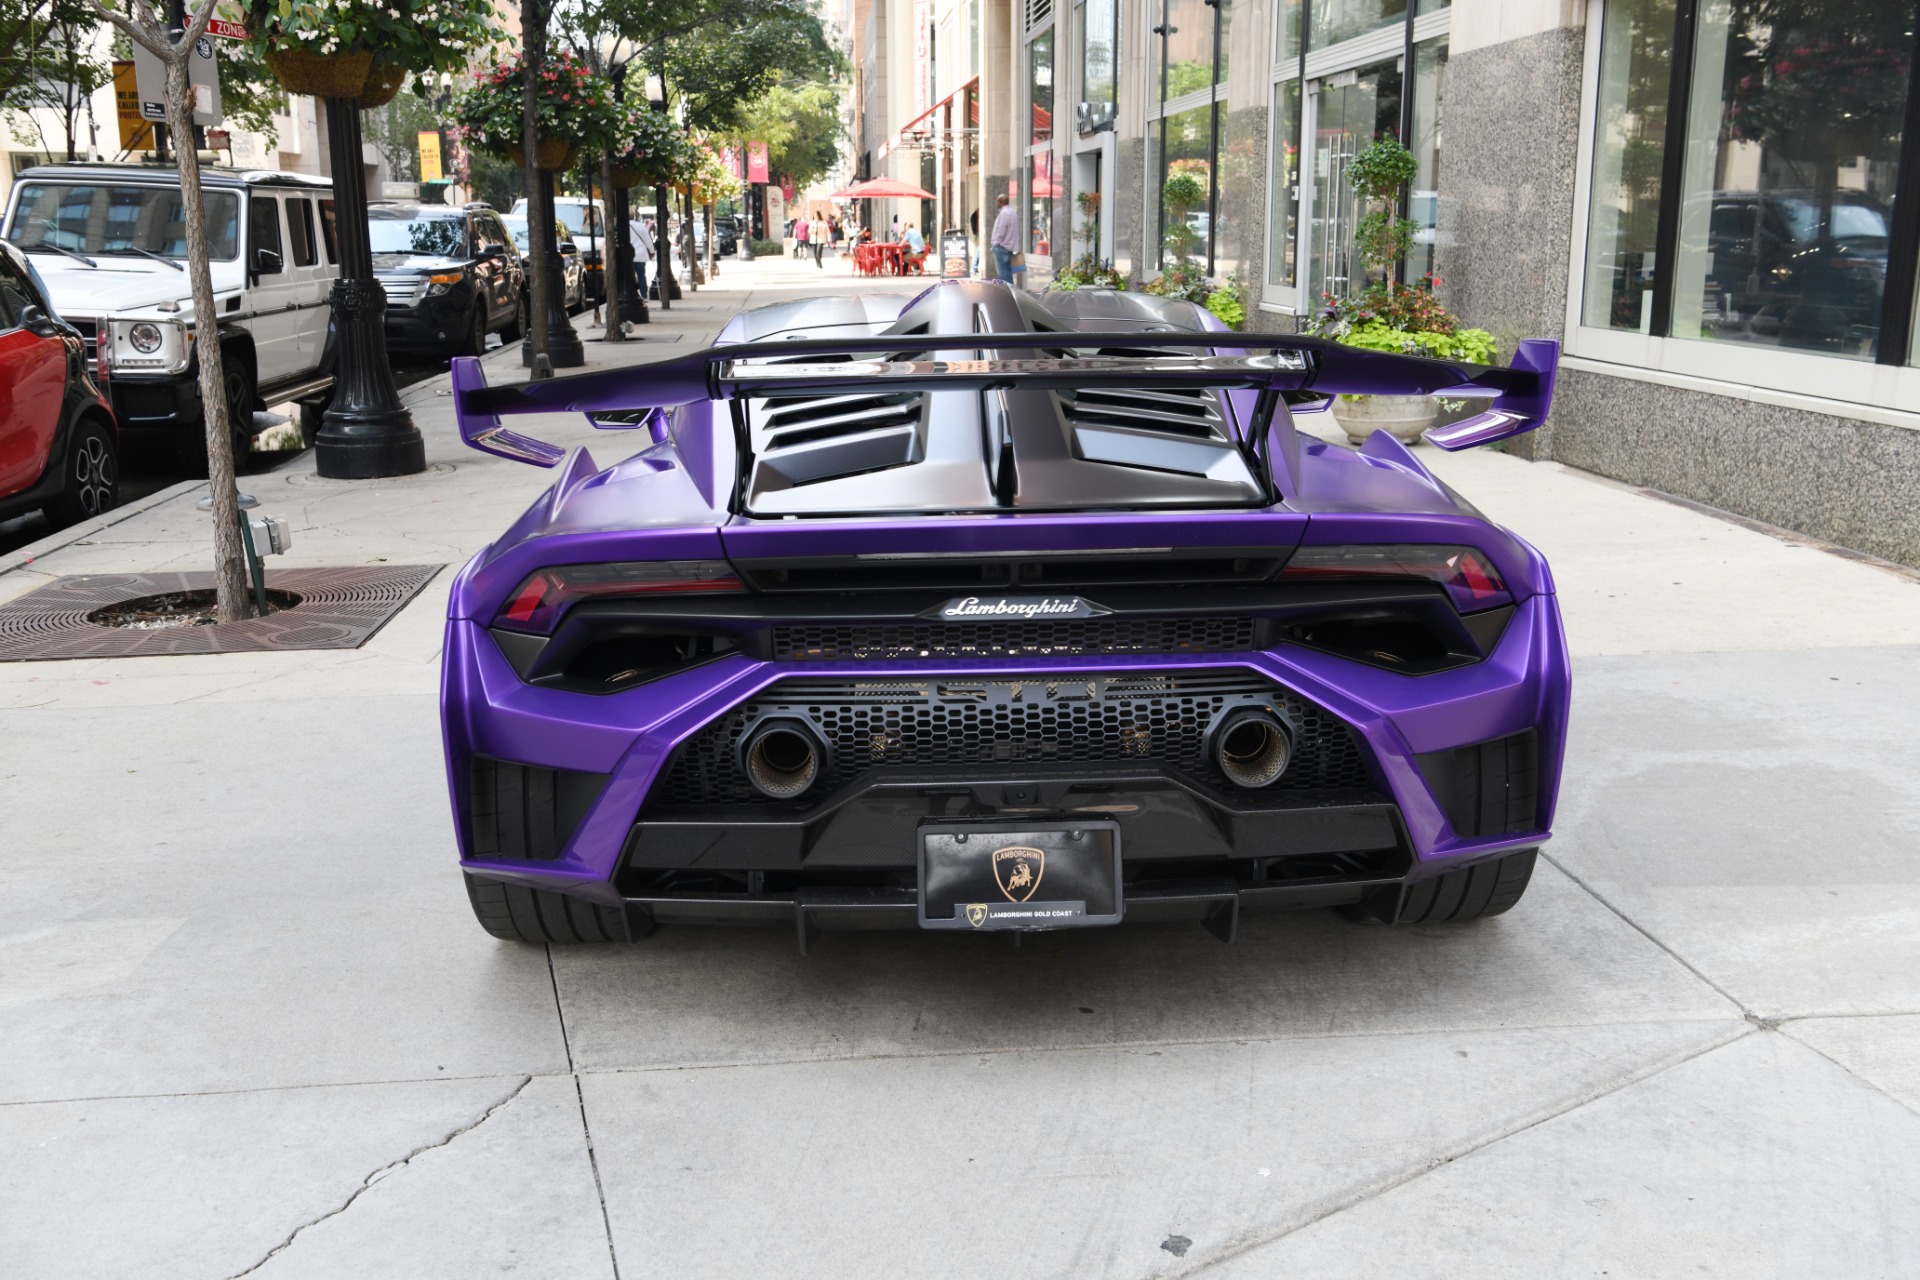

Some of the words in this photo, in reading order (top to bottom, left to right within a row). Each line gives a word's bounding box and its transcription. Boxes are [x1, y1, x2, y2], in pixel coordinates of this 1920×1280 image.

[945, 597, 1078, 618] Lamborghini
[996, 850, 1040, 862] LAMBORGHINI
[989, 911, 1033, 919] LAMBORGHINI
[1052, 910, 1073, 918] COAST
